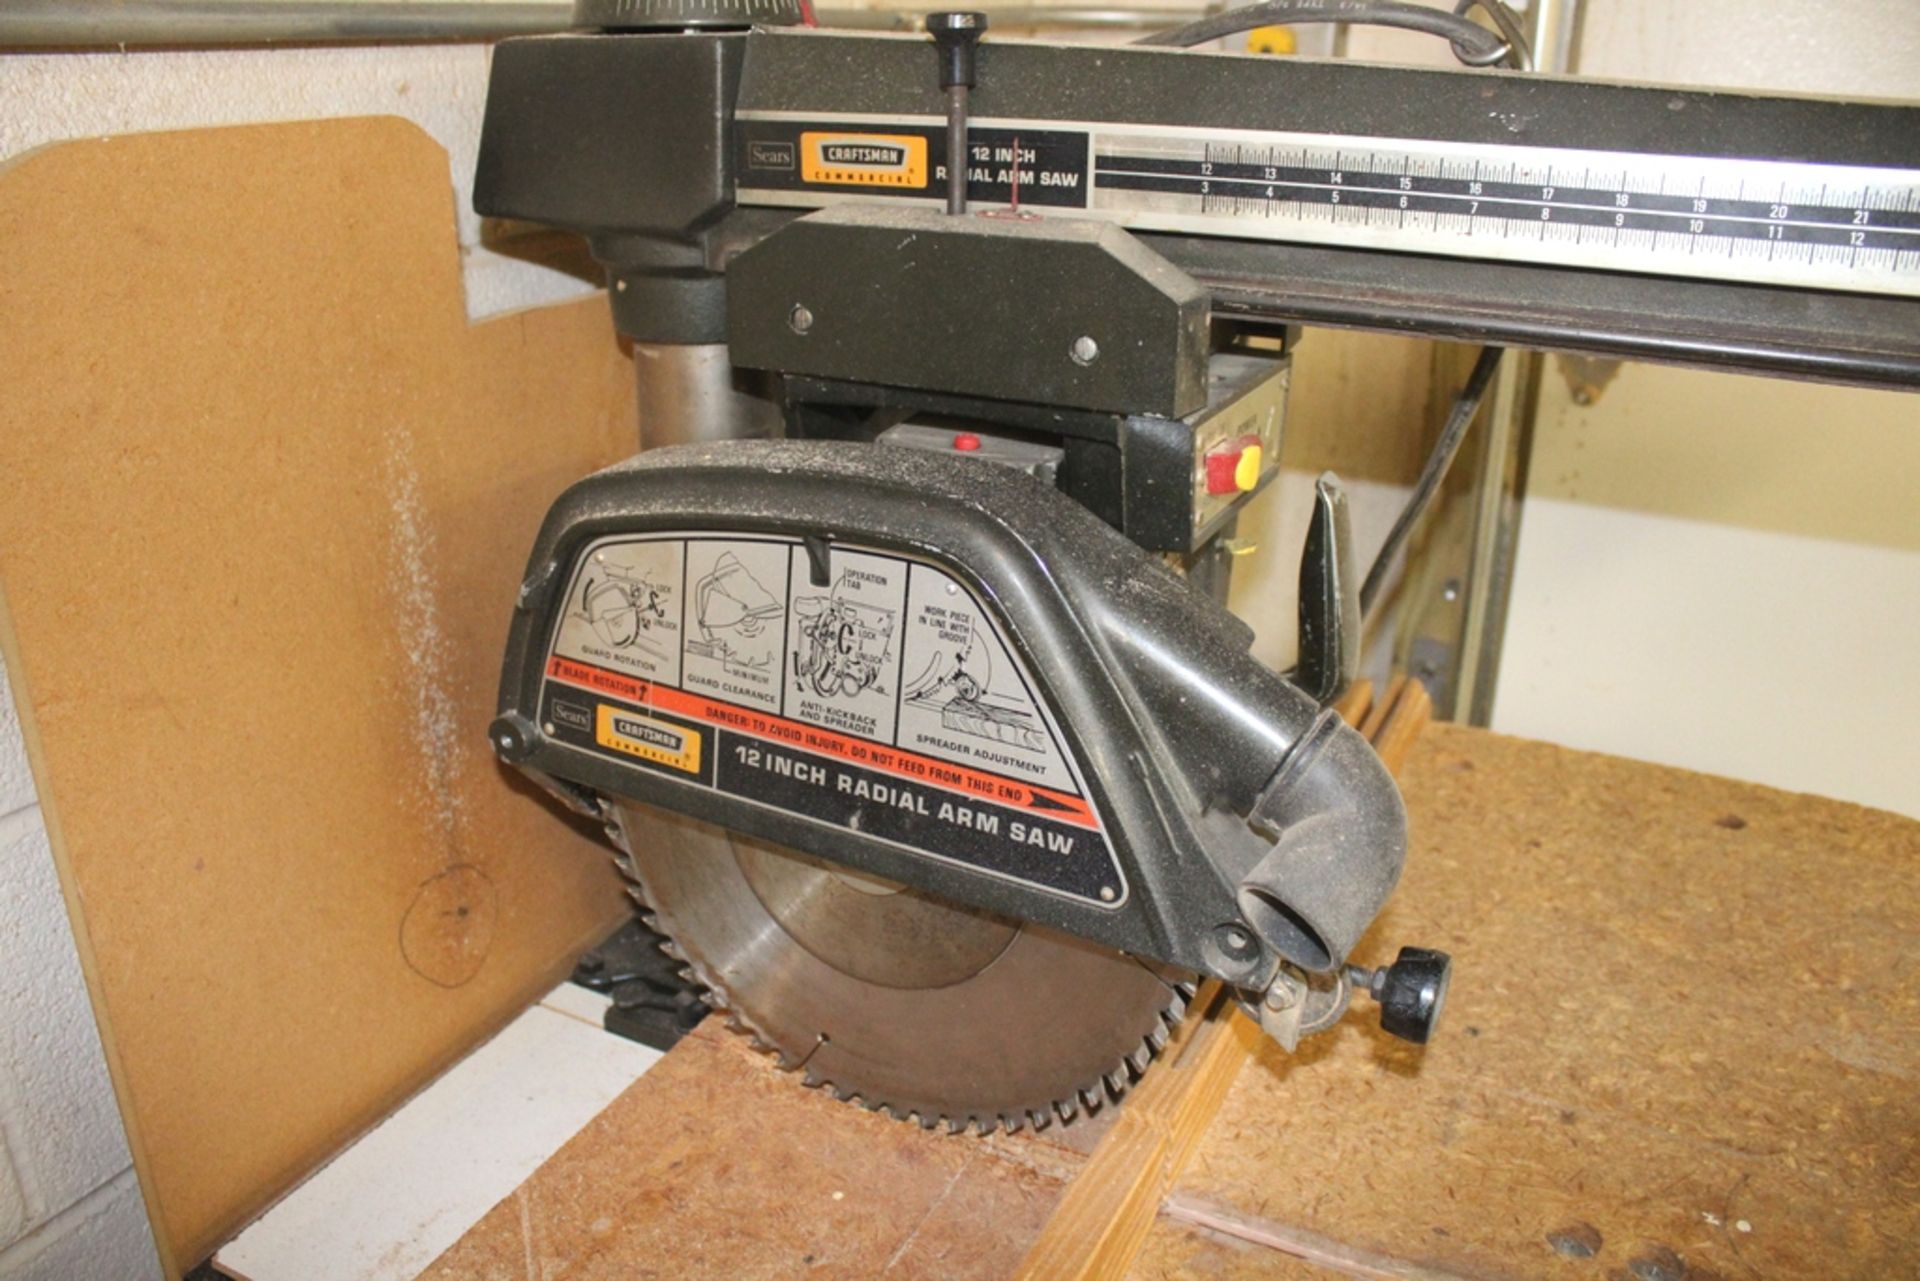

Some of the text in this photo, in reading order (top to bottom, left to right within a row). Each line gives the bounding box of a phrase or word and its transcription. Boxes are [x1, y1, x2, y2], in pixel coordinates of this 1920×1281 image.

[751, 147, 791, 164] Sears
[828, 147, 898, 163] CRAFTSMAN
[972, 147, 1036, 163] 12 INCH
[814, 171, 912, 185] COMMERCIAL
[1040, 172, 1079, 187] SAW
[1201, 163, 1869, 225] 12 13 14 15 16 17 18 19 20 21
[1201, 181, 1865, 246] 3 4 5 6 7 8 9 10 11 12
[846, 569, 888, 586] OPERATION
[847, 580, 861, 590] TAB
[918, 616, 970, 634] IN LINE WITH
[924, 605, 971, 624] WORK PIECE
[938, 629, 968, 645] GROOVE
[581, 645, 657, 672] GUARD ROTATION
[562, 665, 637, 695] BLADE ROTATION
[731, 669, 769, 684] MINIMUM
[687, 673, 776, 705] GUARD CLEARANCE
[555, 704, 588, 725] Sears
[800, 700, 877, 727] ANTI-KICKBACK
[800, 709, 875, 736] AND SPREADER
[618, 720, 678, 749] CRAFTSMAN
[606, 737, 688, 769] COMMERCIAL
[753, 718, 767, 732] TO
[769, 724, 801, 742] AVOID
[852, 745, 867, 759] DO
[871, 751, 894, 767] NOT
[897, 758, 926, 774] FEED
[929, 766, 962, 784] FROM
[966, 776, 994, 794] THIS
[999, 785, 1023, 802] END
[916, 733, 1047, 775] SPREADER ADJUSTMENT
[735, 745, 1075, 855] 12 INCH RADIAL ARM SAW
